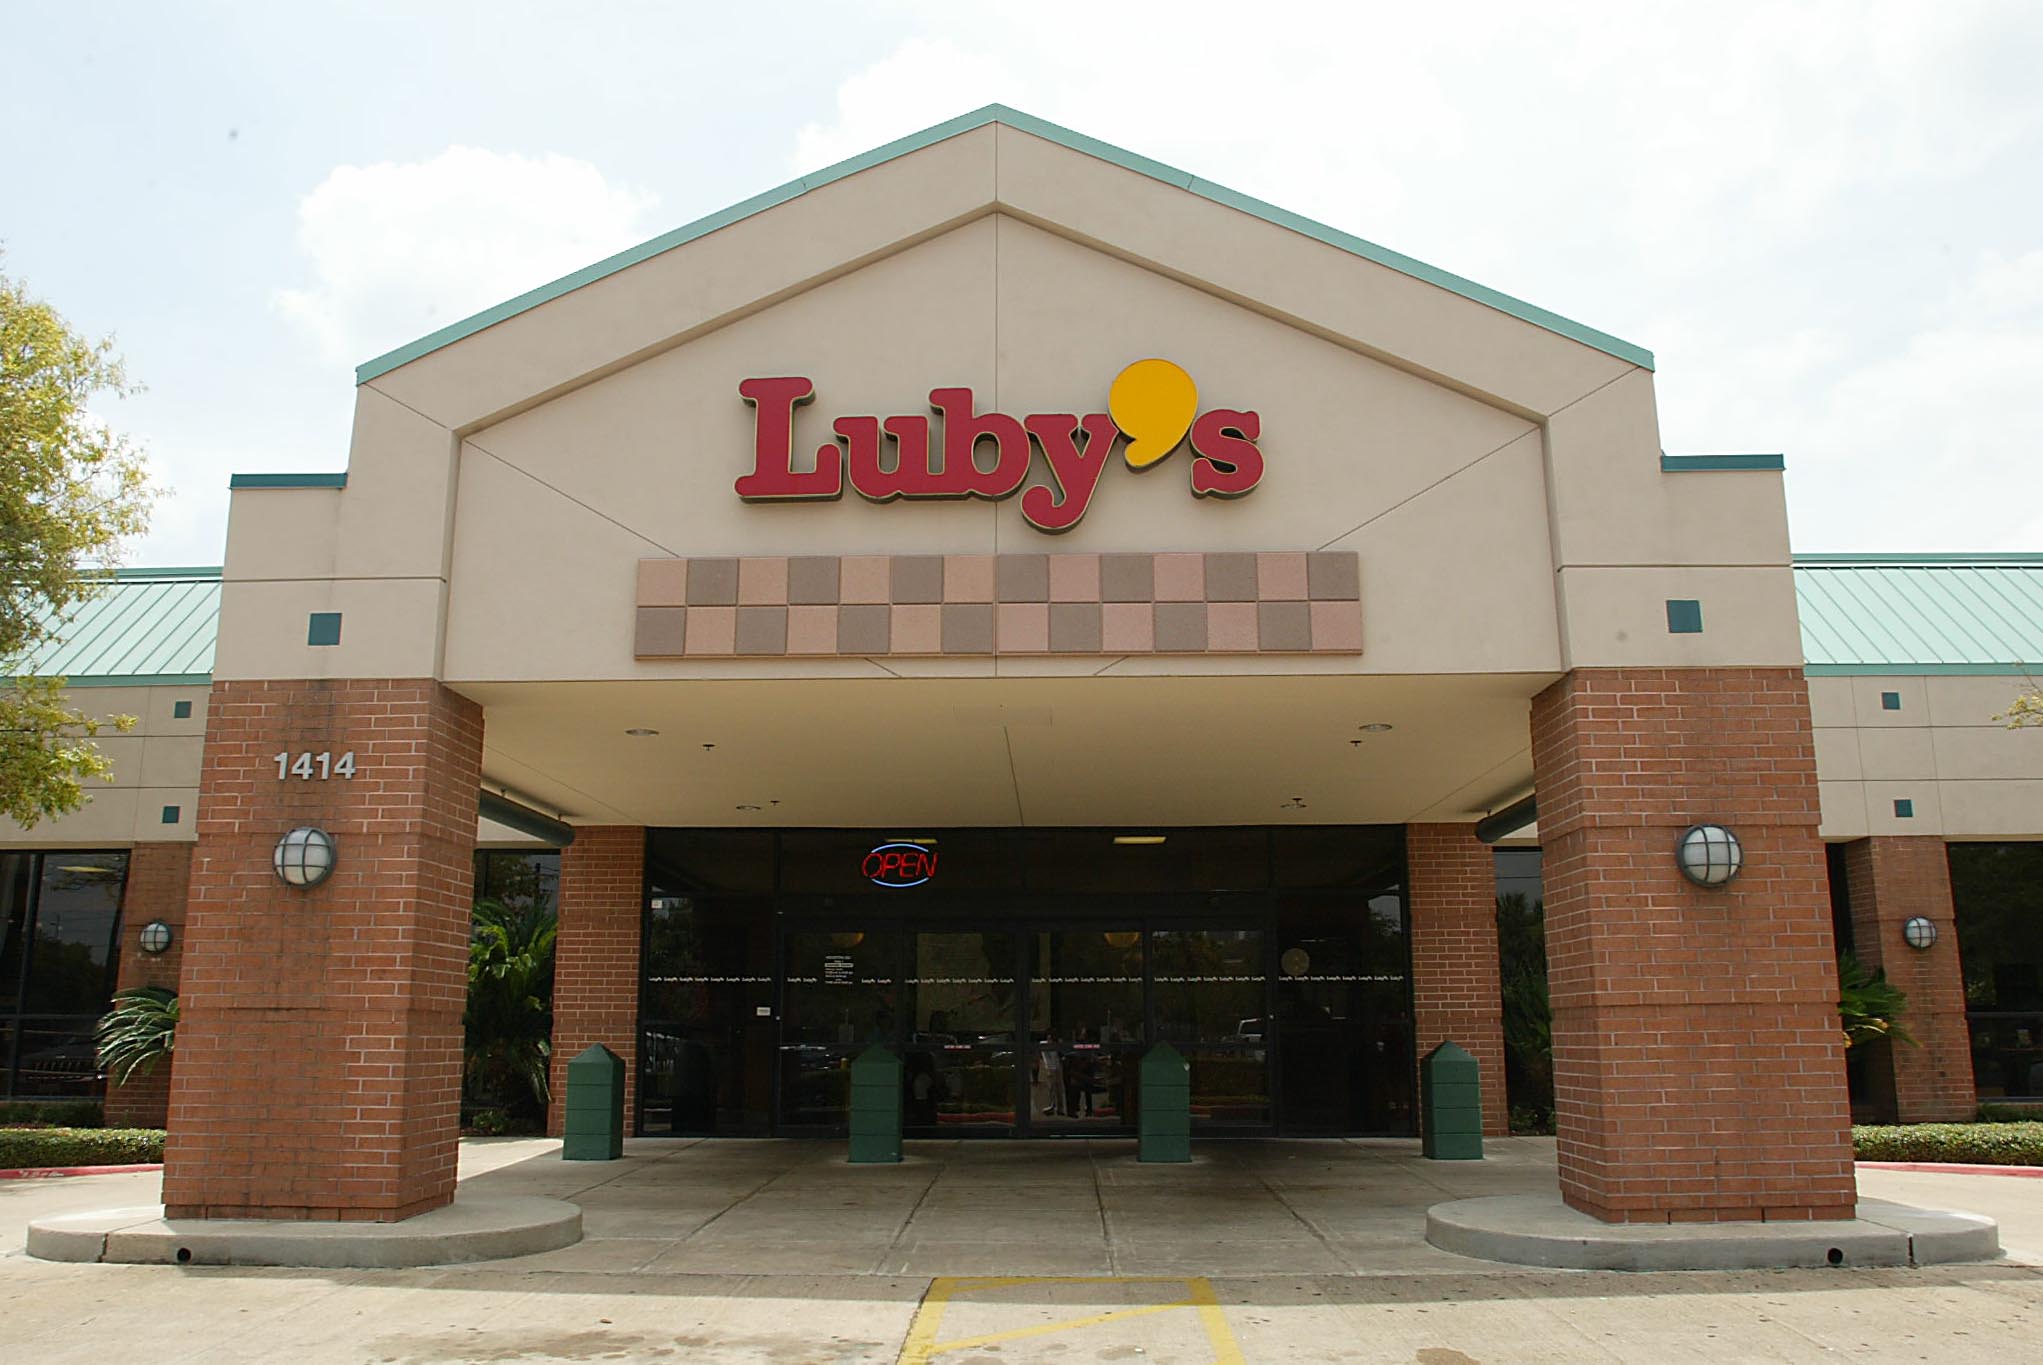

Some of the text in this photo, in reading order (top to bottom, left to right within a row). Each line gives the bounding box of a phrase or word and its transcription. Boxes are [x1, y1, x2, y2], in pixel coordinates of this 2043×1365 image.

[734, 358, 1265, 534] Luby's
[274, 751, 356, 780] 1414
[862, 852, 938, 878] OPEN
